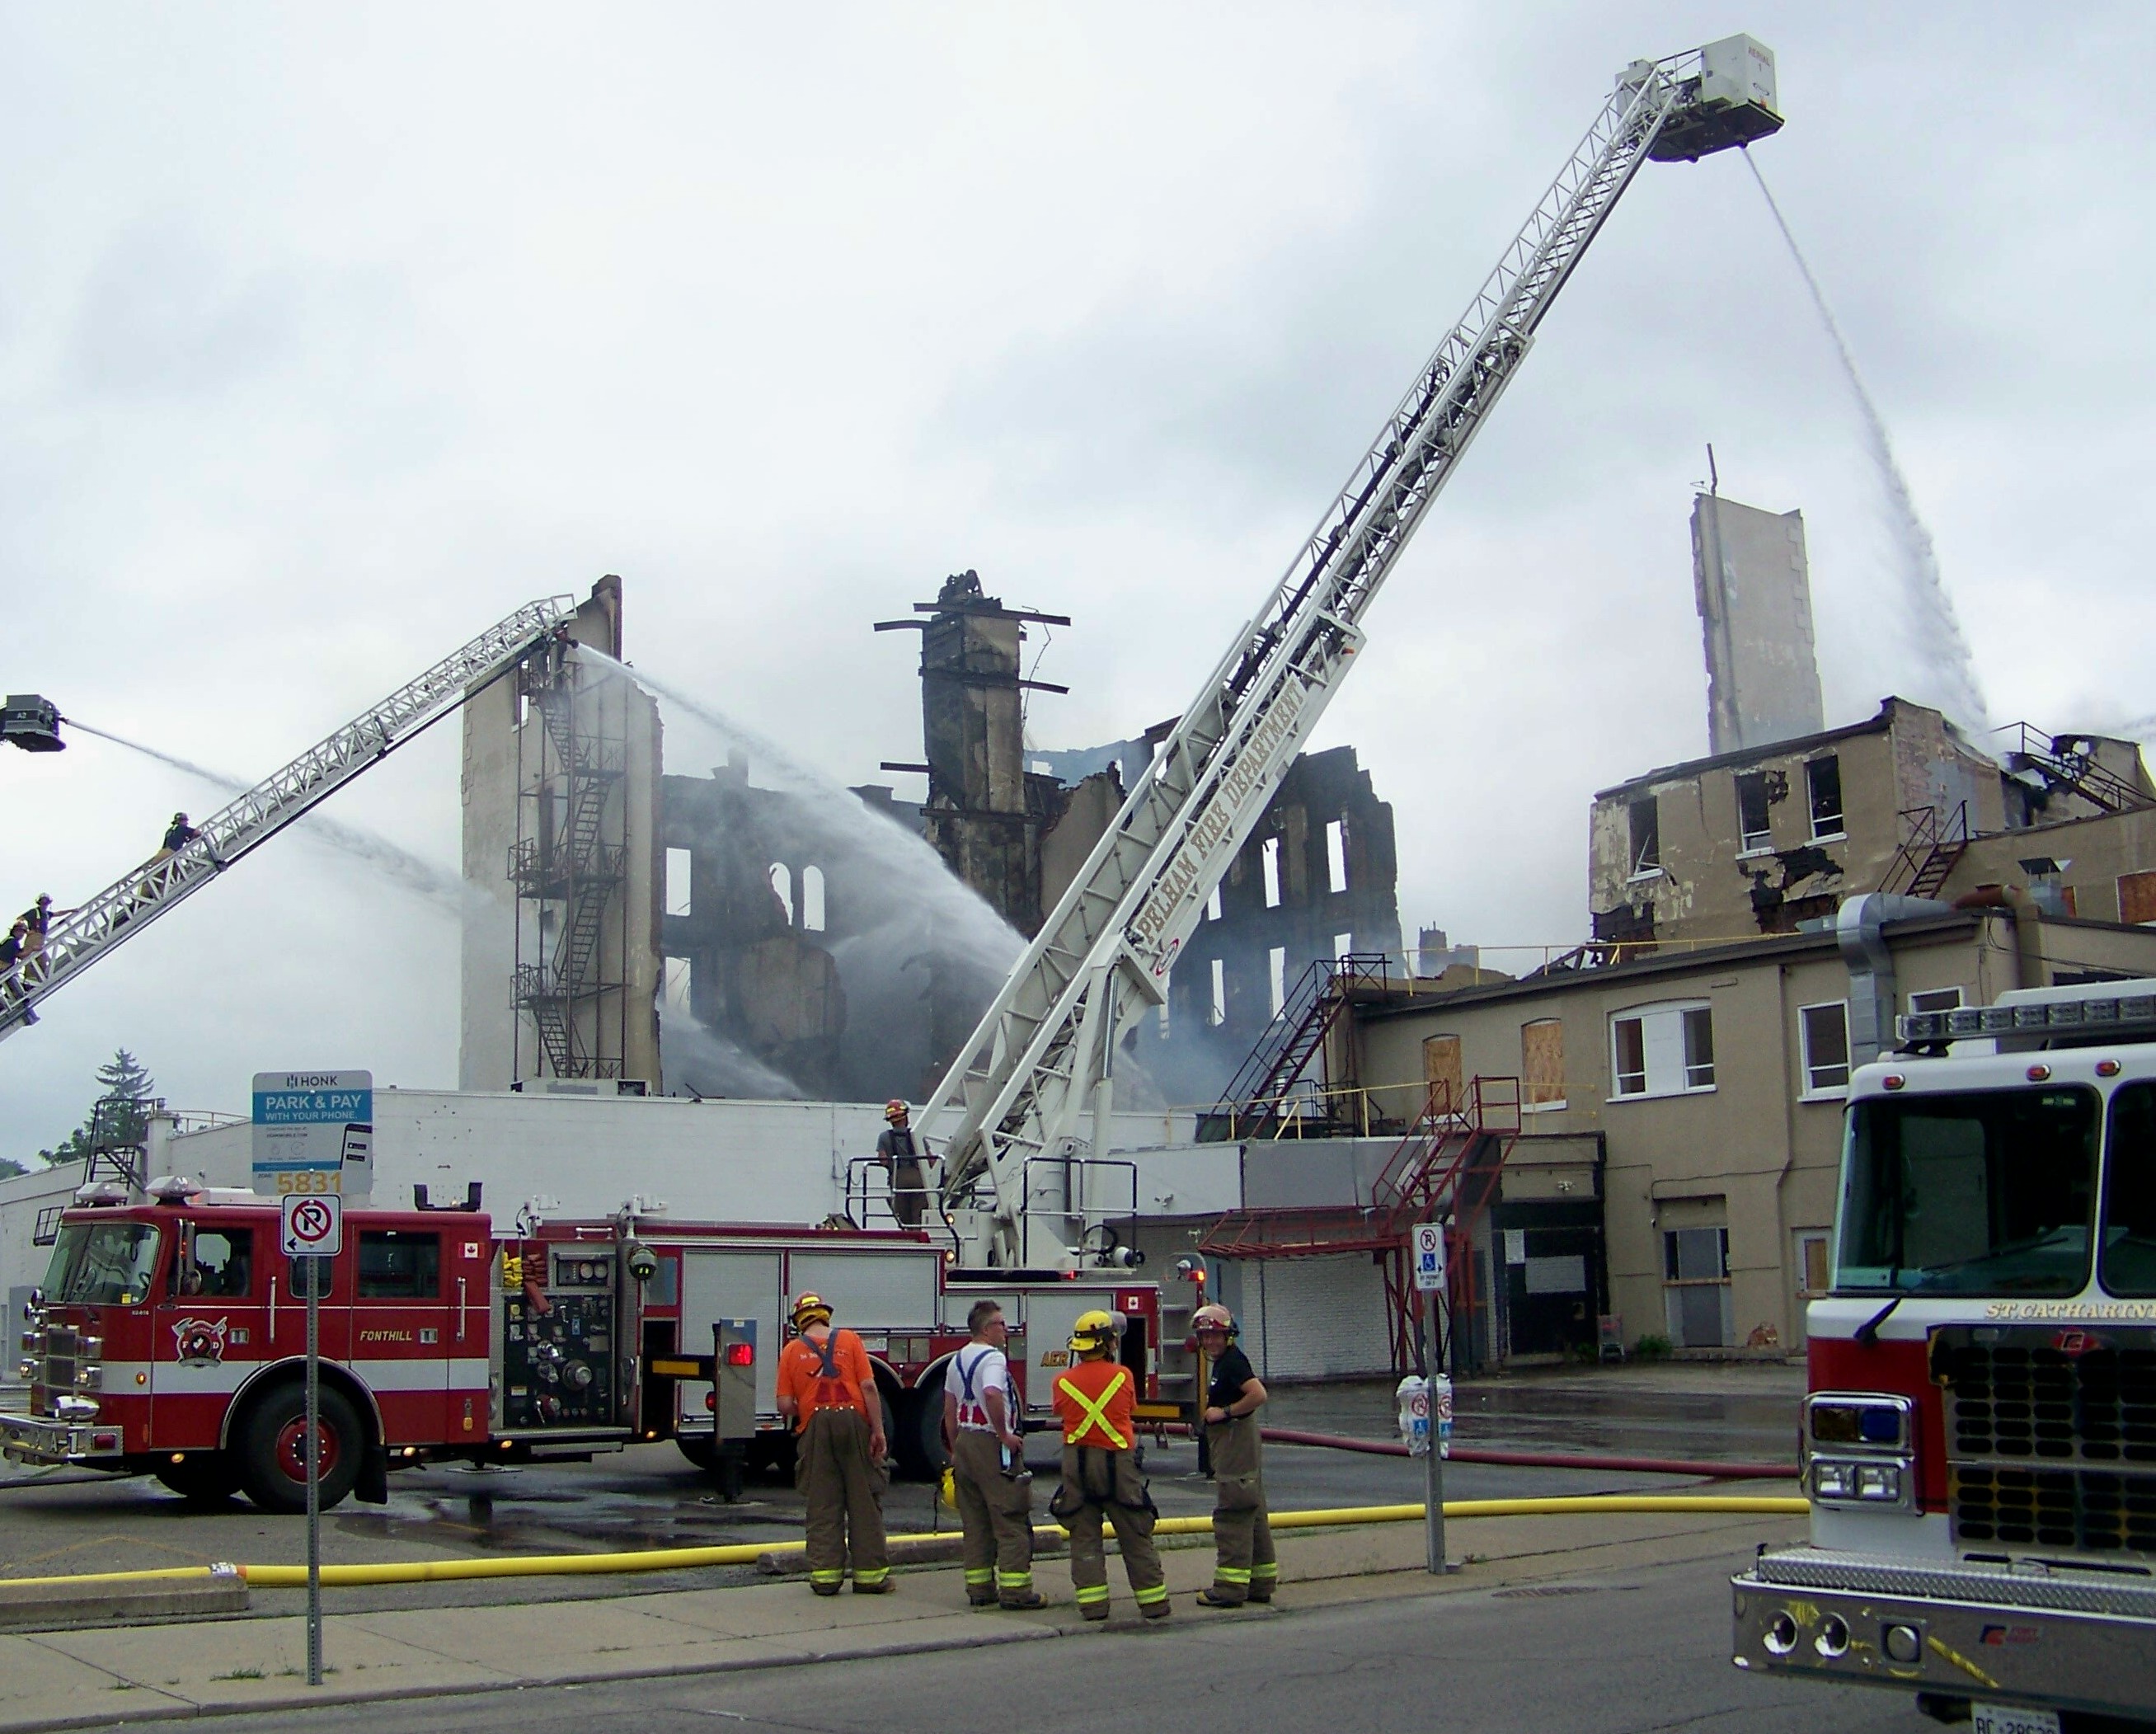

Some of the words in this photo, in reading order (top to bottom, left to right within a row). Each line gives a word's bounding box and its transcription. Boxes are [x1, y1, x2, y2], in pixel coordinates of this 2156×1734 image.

[1136, 850, 1199, 946] PELHAM
[1191, 799, 1231, 862] FIRE
[1221, 679, 1304, 810] DEPARTMENT
[301, 1075, 338, 1087] HONK
[265, 1095, 310, 1110] PARK
[314, 1095, 326, 1109] &
[331, 1094, 362, 1108] PAY
[265, 1111, 289, 1121] WITH
[292, 1111, 319, 1121] YOUR
[321, 1111, 358, 1120] PHONE.
[277, 1171, 342, 1194] 5831
[359, 1330, 413, 1342] FONTHILL
[1040, 1351, 1069, 1366] AER
